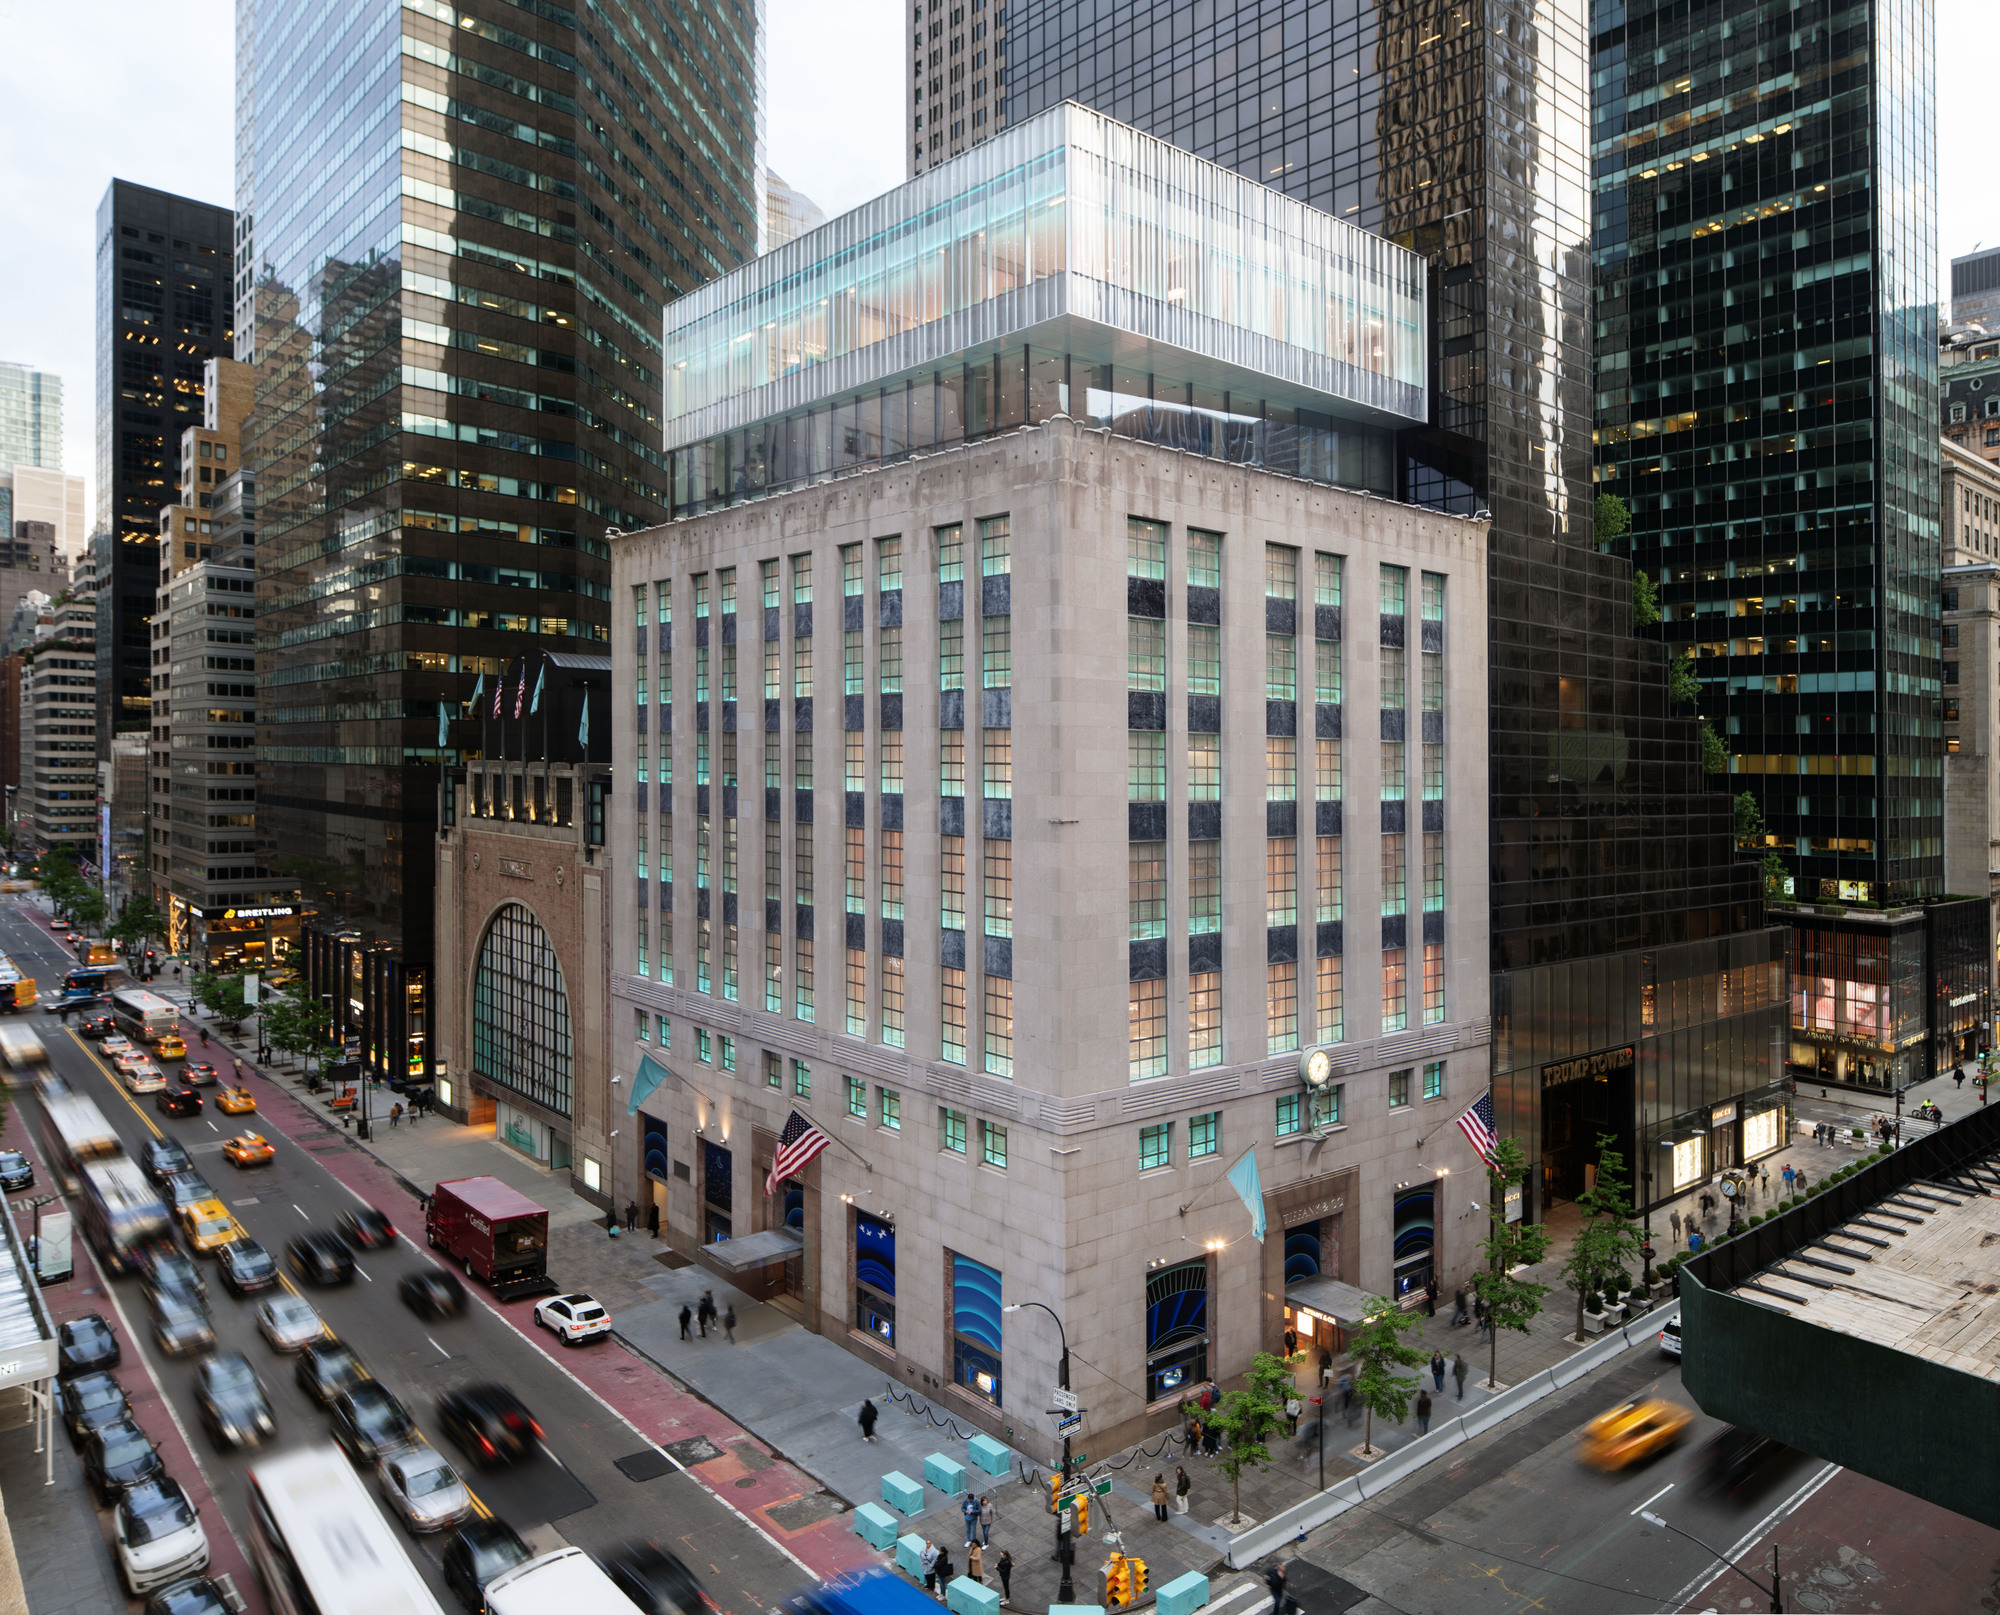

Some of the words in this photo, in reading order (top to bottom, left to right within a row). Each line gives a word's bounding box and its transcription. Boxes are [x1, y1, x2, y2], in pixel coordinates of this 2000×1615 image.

[237, 907, 293, 918] BREITLING
[1806, 1031, 1833, 1042] ARMANI
[1852, 1038, 1884, 1049] AVENUE
[1544, 1058, 1589, 1087] TRUMP
[1590, 1047, 1633, 1075] TOWER
[1712, 1106, 1731, 1120] GUCCI
[1504, 1192, 1520, 1203] UCCI
[1282, 1203, 1321, 1225] TIFFANY
[469, 1213, 491, 1237] Certified
[1302, 1306, 1324, 1320] TIFFANY
[1054, 1388, 1076, 1401] PASSENGER
[1054, 1396, 1064, 1405] CARS
[1065, 1400, 1076, 1409] ONLY
